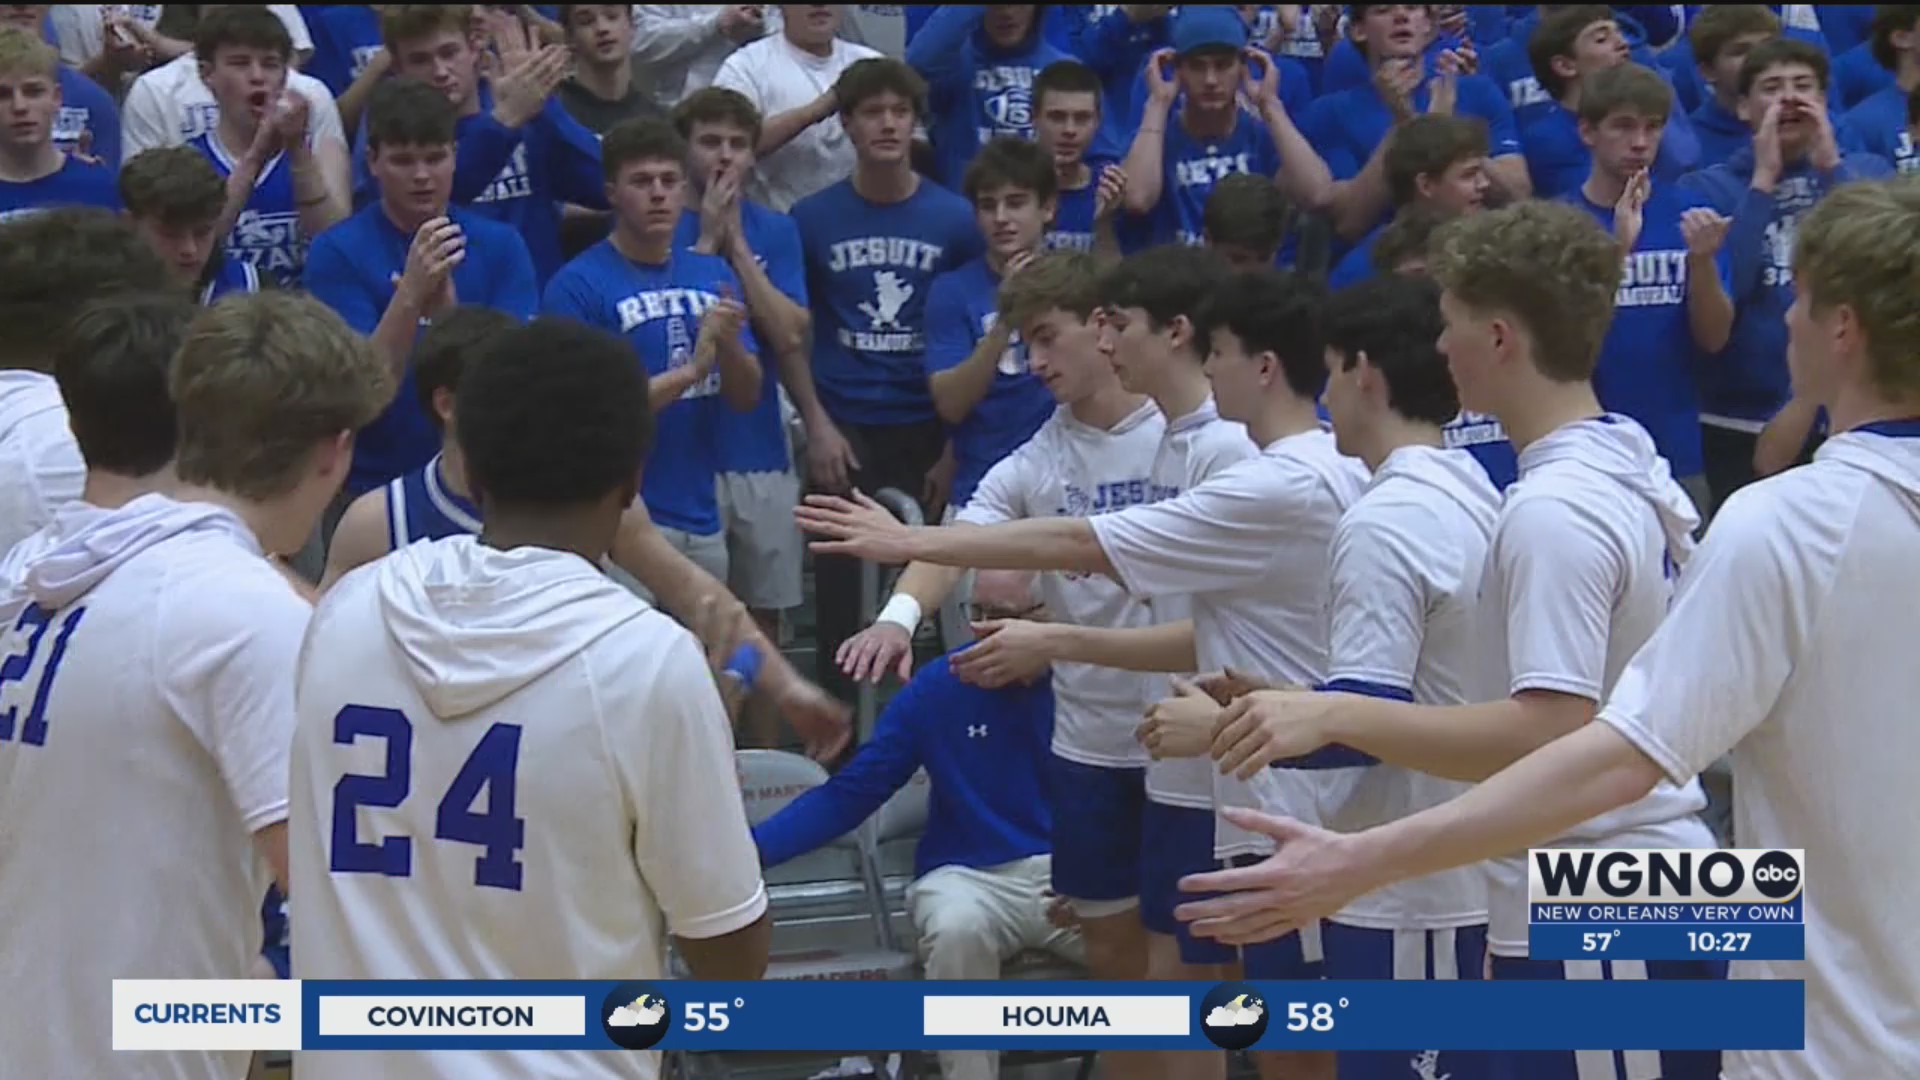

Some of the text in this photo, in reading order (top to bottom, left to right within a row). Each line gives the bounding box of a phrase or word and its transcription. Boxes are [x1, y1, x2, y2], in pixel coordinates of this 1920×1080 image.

[829, 236, 944, 271] JESUIT
[0, 601, 87, 747] 21
[330, 703, 525, 892] 24
